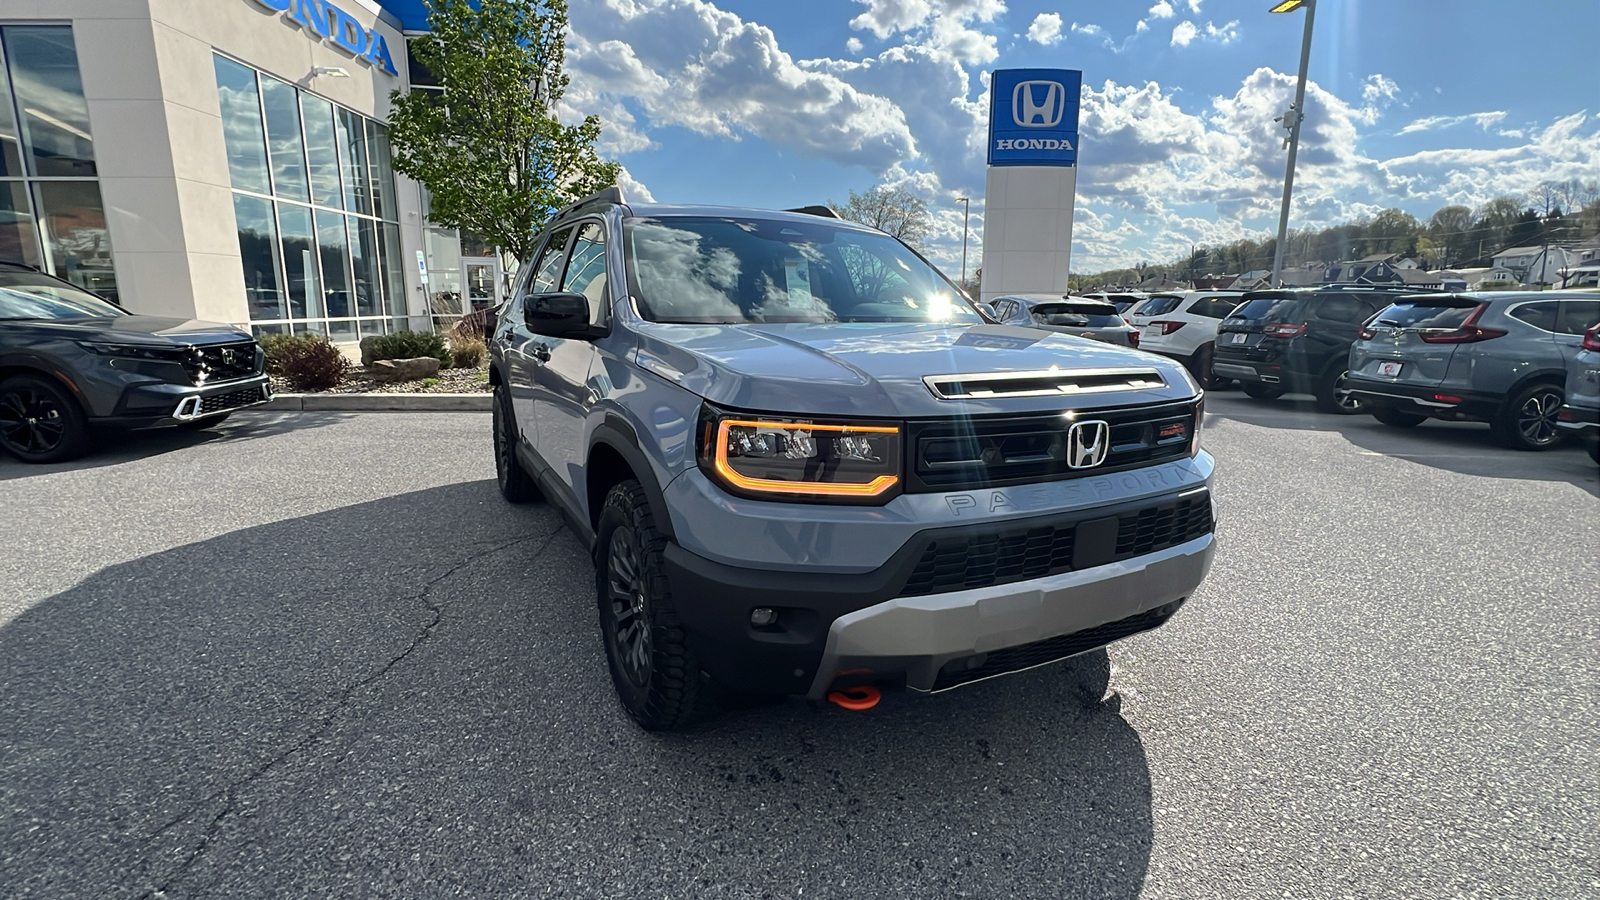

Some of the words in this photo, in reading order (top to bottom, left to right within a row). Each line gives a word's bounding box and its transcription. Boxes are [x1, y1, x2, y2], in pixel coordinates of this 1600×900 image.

[262, 0, 398, 77] NDA
[996, 138, 1074, 151] HONDA
[944, 461, 1205, 516] PASSPORT
